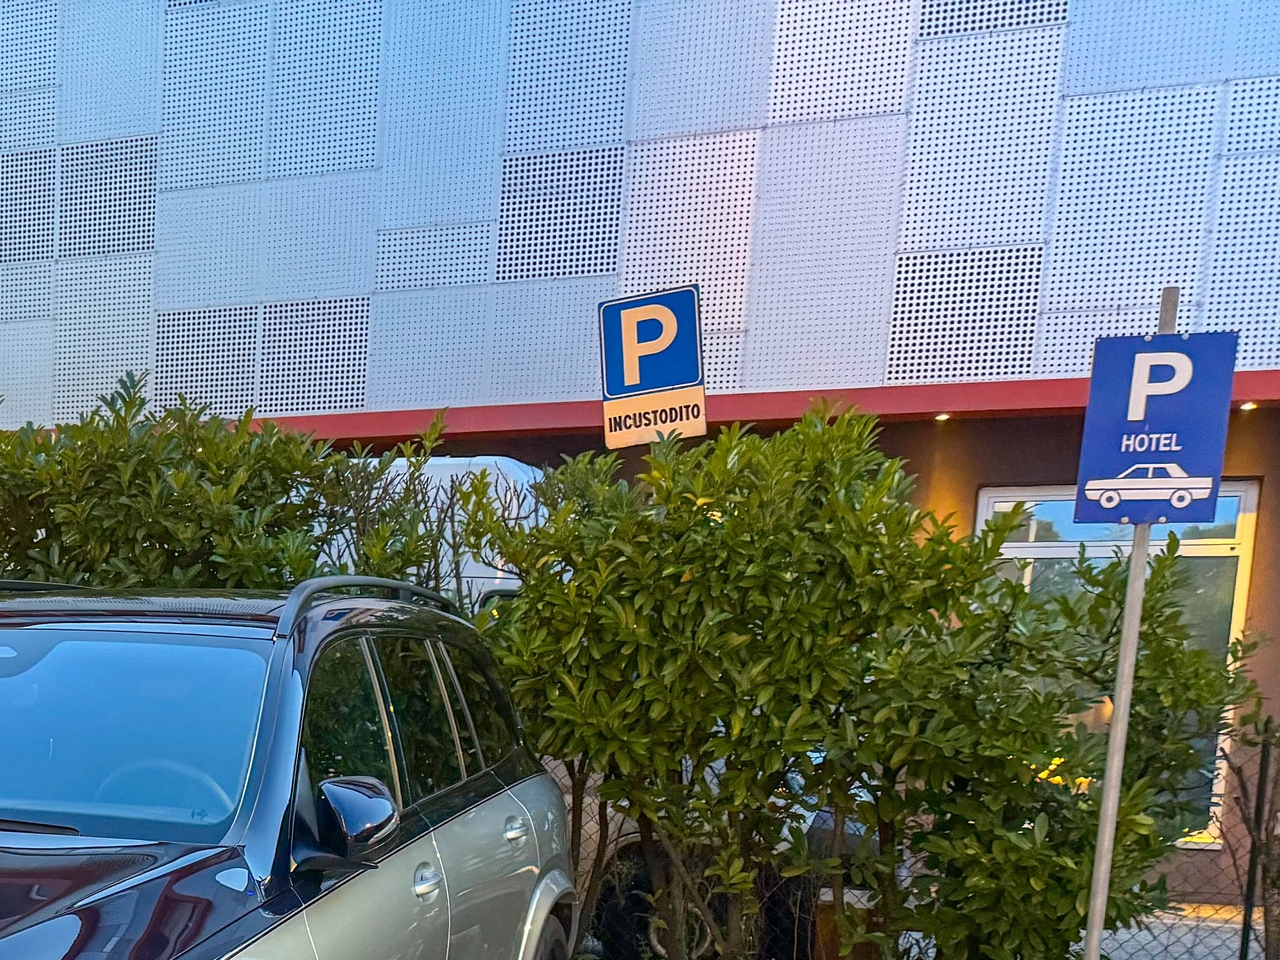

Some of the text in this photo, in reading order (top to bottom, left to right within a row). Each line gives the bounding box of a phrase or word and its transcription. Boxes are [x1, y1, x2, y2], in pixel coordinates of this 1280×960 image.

[621, 304, 678, 386] P
[1127, 352, 1193, 421] P
[608, 403, 701, 433] INCUSTODITO
[1121, 433, 1182, 452] HOTEL
